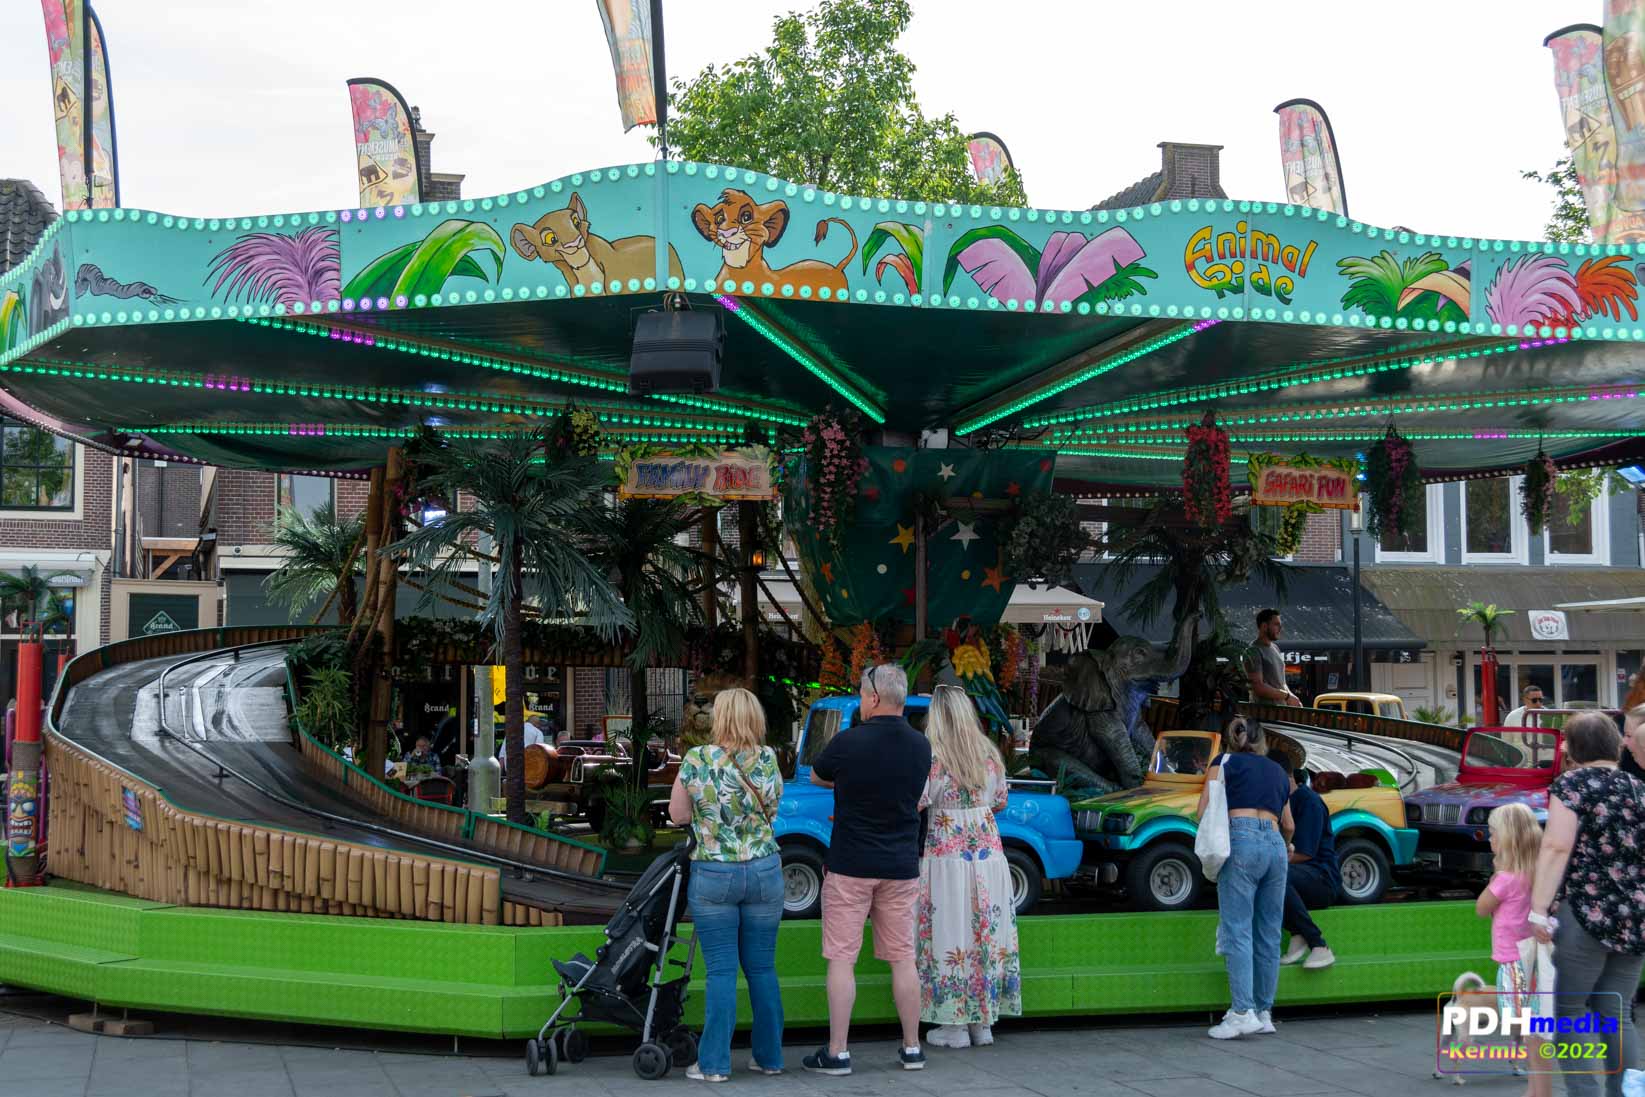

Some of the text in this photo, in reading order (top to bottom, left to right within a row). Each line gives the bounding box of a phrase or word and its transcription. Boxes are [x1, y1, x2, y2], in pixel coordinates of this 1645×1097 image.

[1184, 220, 1319, 279] Animal
[1188, 260, 1295, 306] Ride
[1317, 475, 1346, 499] FUN
[424, 702, 450, 713] Brand
